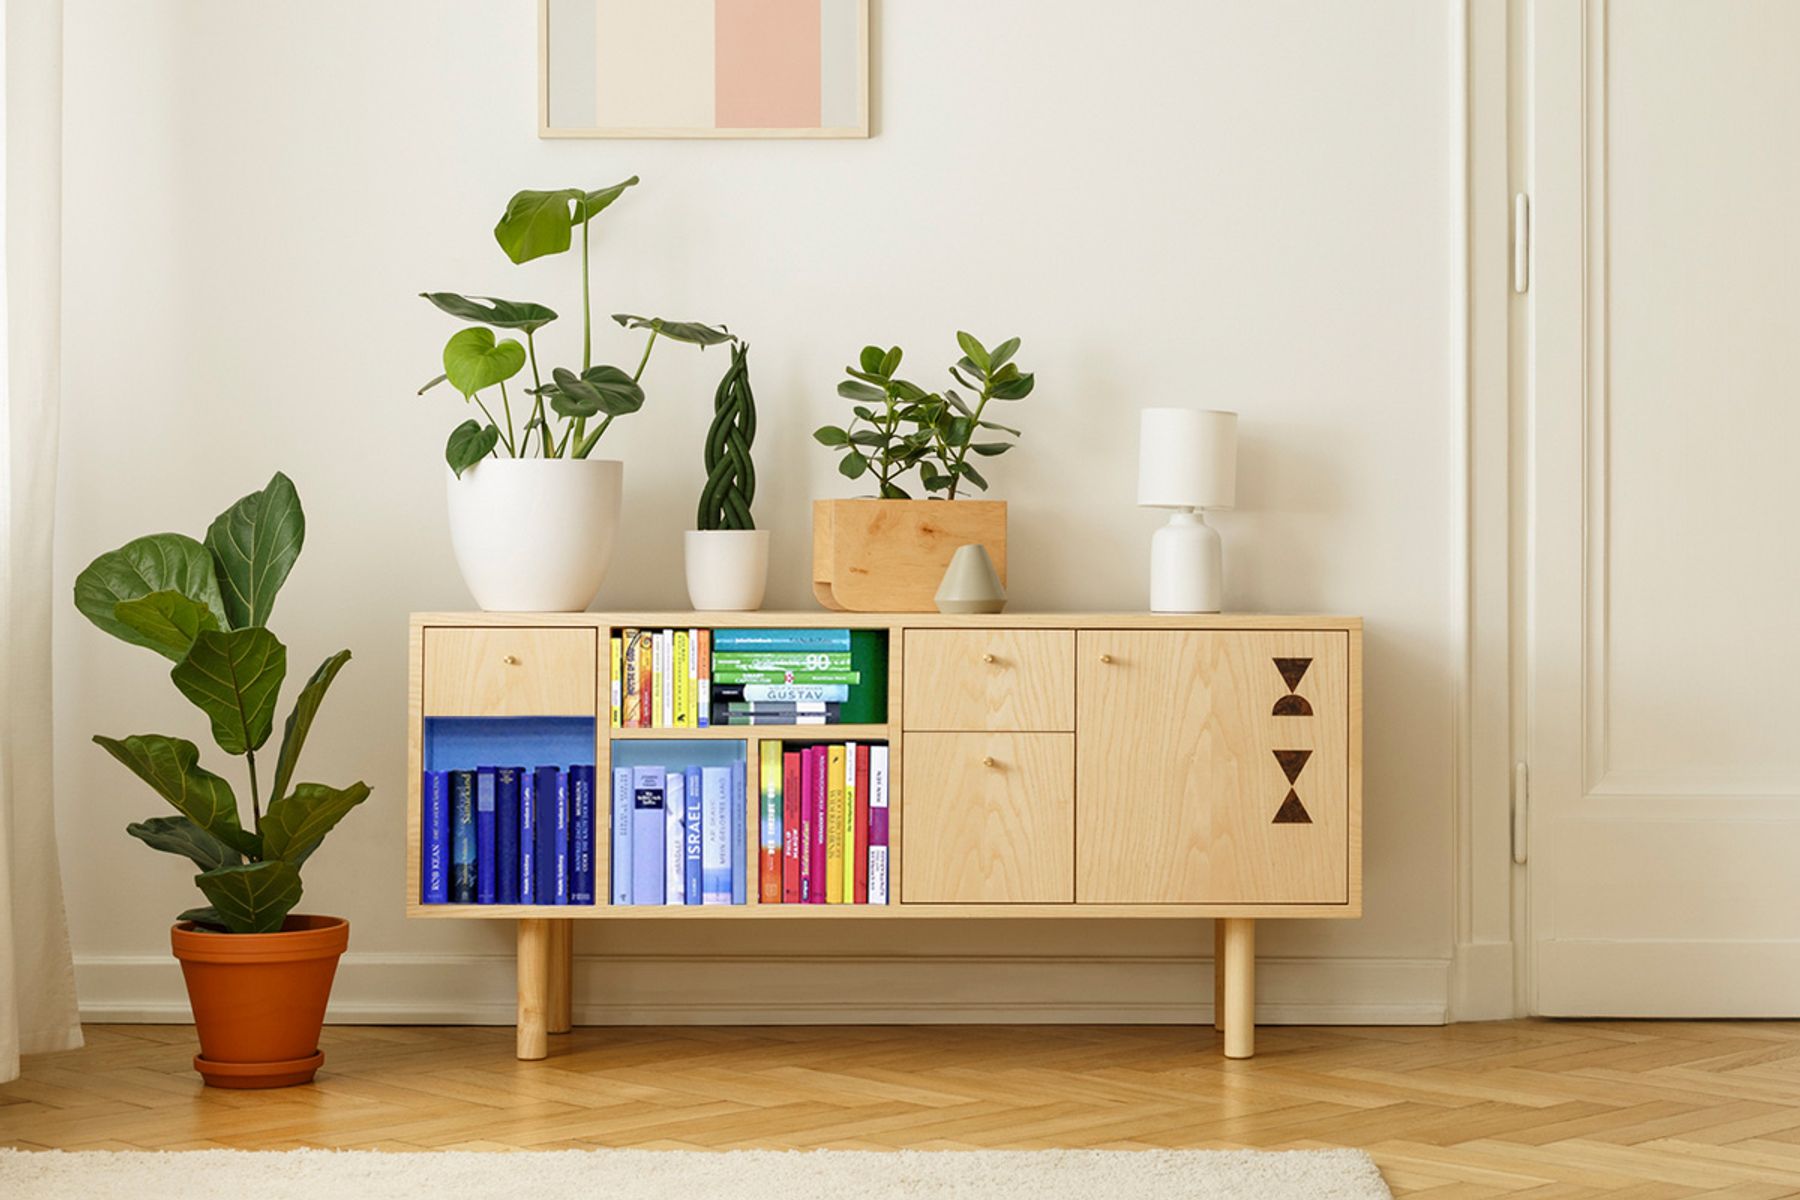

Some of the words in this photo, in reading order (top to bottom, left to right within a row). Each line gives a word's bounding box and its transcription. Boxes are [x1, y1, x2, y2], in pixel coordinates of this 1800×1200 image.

[766, 690, 824, 700] GUSTAV
[462, 773, 472, 824] Samarkand
[688, 802, 701, 860] ISRAEL
